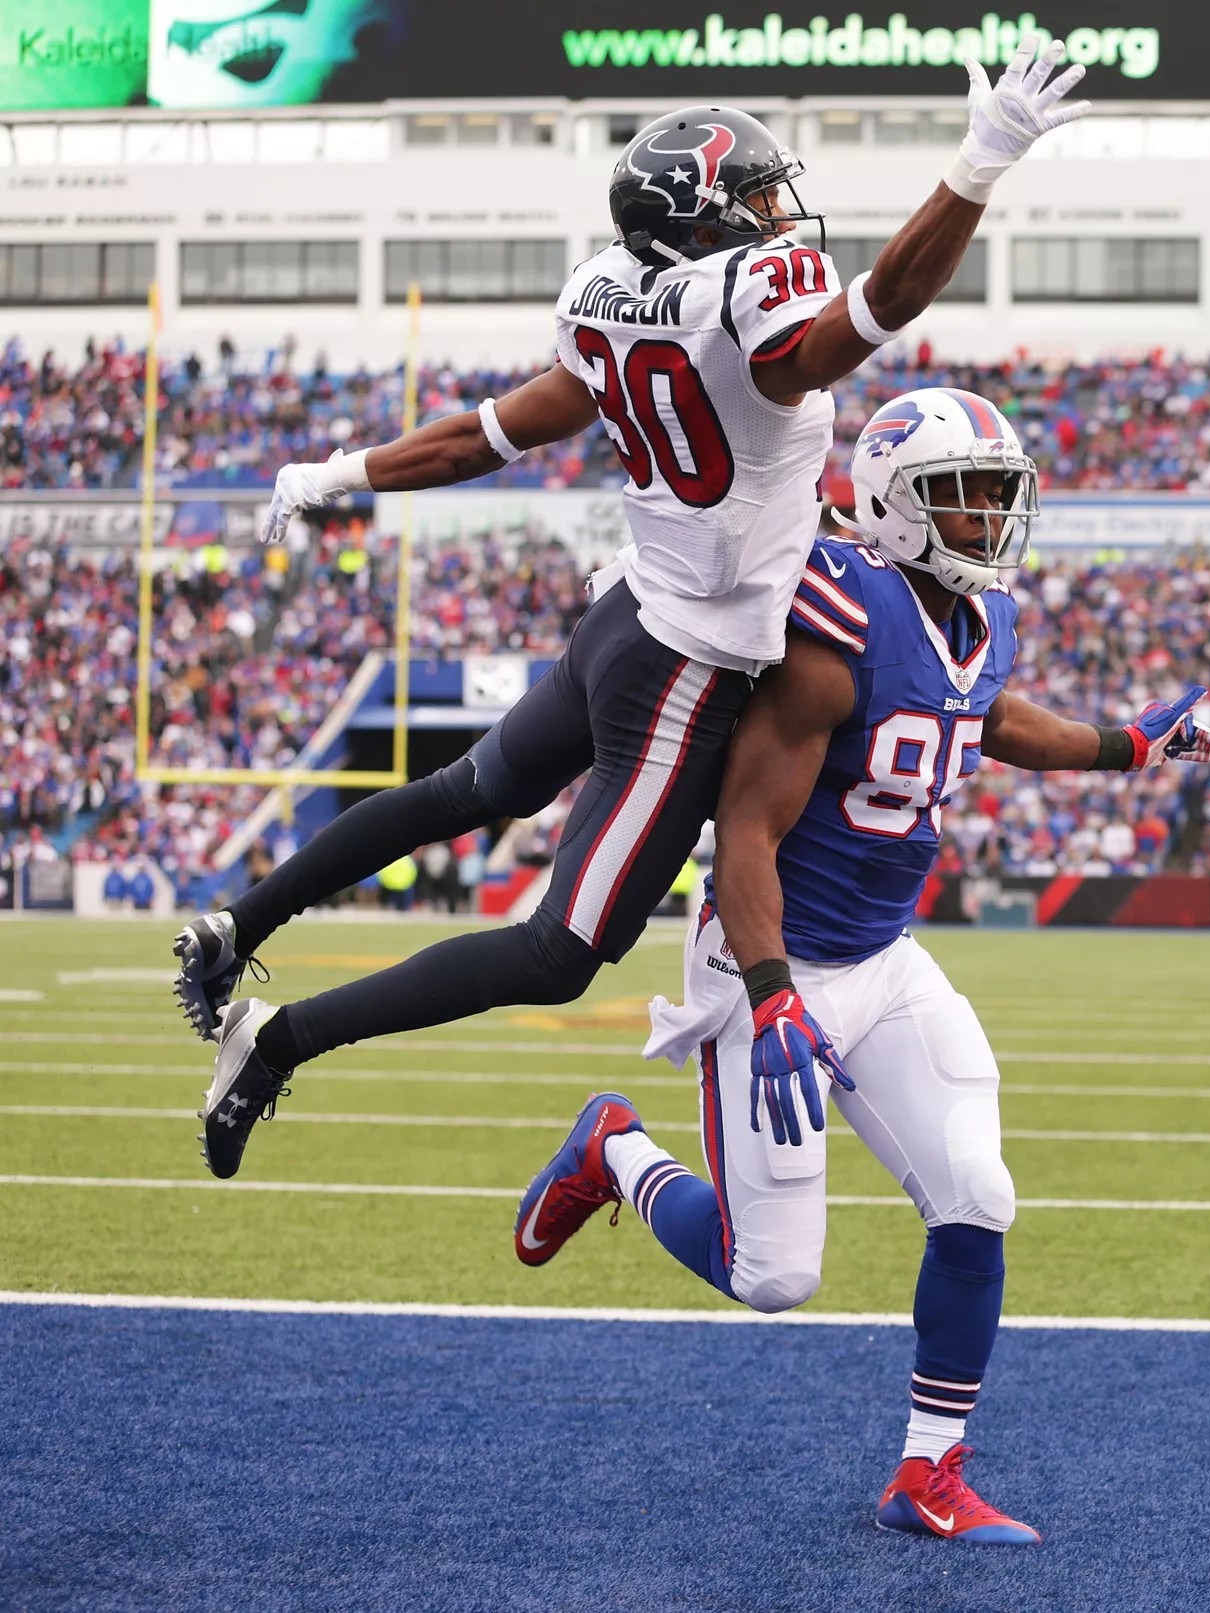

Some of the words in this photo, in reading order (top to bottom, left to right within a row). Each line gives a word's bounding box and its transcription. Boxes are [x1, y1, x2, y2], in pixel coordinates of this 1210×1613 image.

[18, 25, 147, 66] Kaleida
[562, 13, 1159, 79] www.kaleidahealth.org
[568, 274, 691, 326] JOHNSON
[749, 248, 829, 311] 30
[573, 324, 735, 508] 30
[707, 955, 742, 979] Wilson
